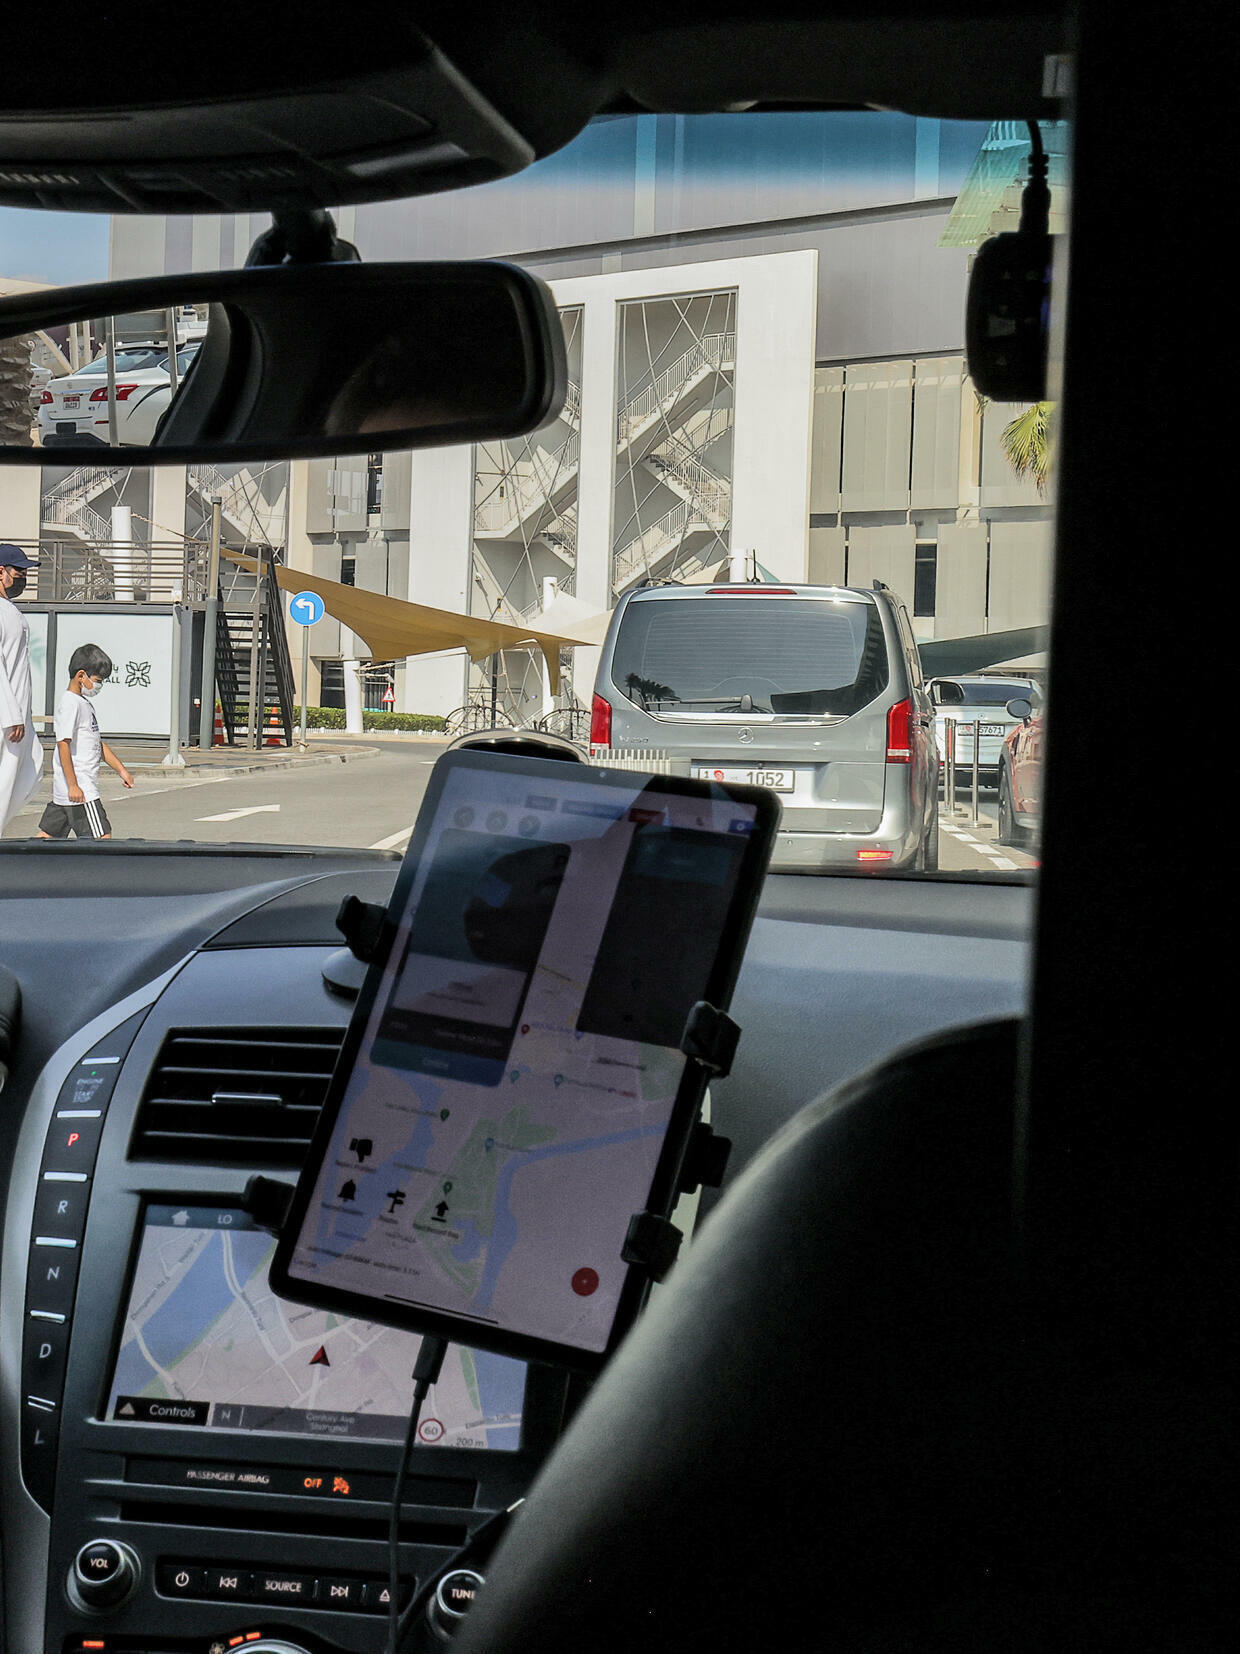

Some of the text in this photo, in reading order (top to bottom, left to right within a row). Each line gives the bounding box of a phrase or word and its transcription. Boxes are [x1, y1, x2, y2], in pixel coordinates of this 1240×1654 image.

[102, 676, 121, 684] ALL
[745, 770, 785, 788] 1052
[67, 1132, 80, 1147] P
[57, 1200, 69, 1214] R
[217, 1214, 233, 1225] LO
[46, 1265, 61, 1281] N
[39, 1343, 52, 1359] D
[148, 1403, 197, 1419] Controls
[34, 1429, 46, 1445] L
[423, 1425, 439, 1435] 60
[455, 1437, 473, 1448] 200
[186, 1470, 270, 1485] PASSENGER AIRBAG
[303, 1476, 323, 1489] OFF
[90, 1557, 109, 1569] VOL
[264, 1579, 303, 1594] SOURCE
